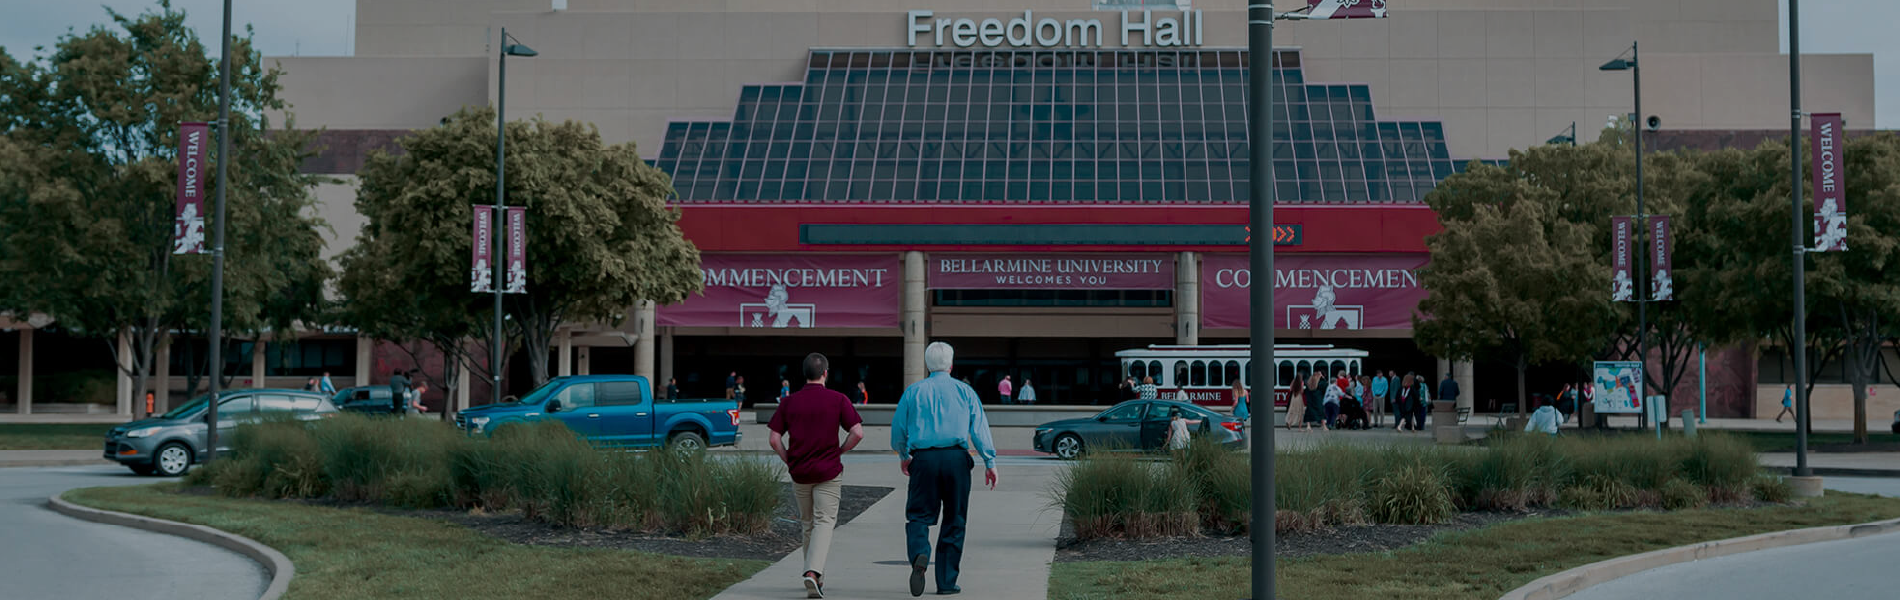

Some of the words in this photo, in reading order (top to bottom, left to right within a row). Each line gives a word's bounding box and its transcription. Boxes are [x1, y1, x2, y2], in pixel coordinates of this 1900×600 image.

[907, 9, 1103, 47] Freedom
[1120, 9, 1203, 47] Hall
[184, 131, 200, 198] WELCOME
[1820, 122, 1836, 193] WELCOME
[478, 211, 488, 256] WELCOME
[513, 212, 521, 258] WELCOME
[1617, 221, 1626, 268] WELCOME
[1655, 220, 1666, 268] WELCOME
[700, 268, 887, 287] MMENCEMENT
[940, 259, 1052, 273] BELLARMINE
[1056, 259, 1163, 273] UNIVERSITY
[995, 275, 1072, 285] WELCOMES
[1079, 275, 1108, 285] YOU
[1215, 268, 1418, 288] COMENCEMEN
[1161, 391, 1222, 401] BELRMINE
